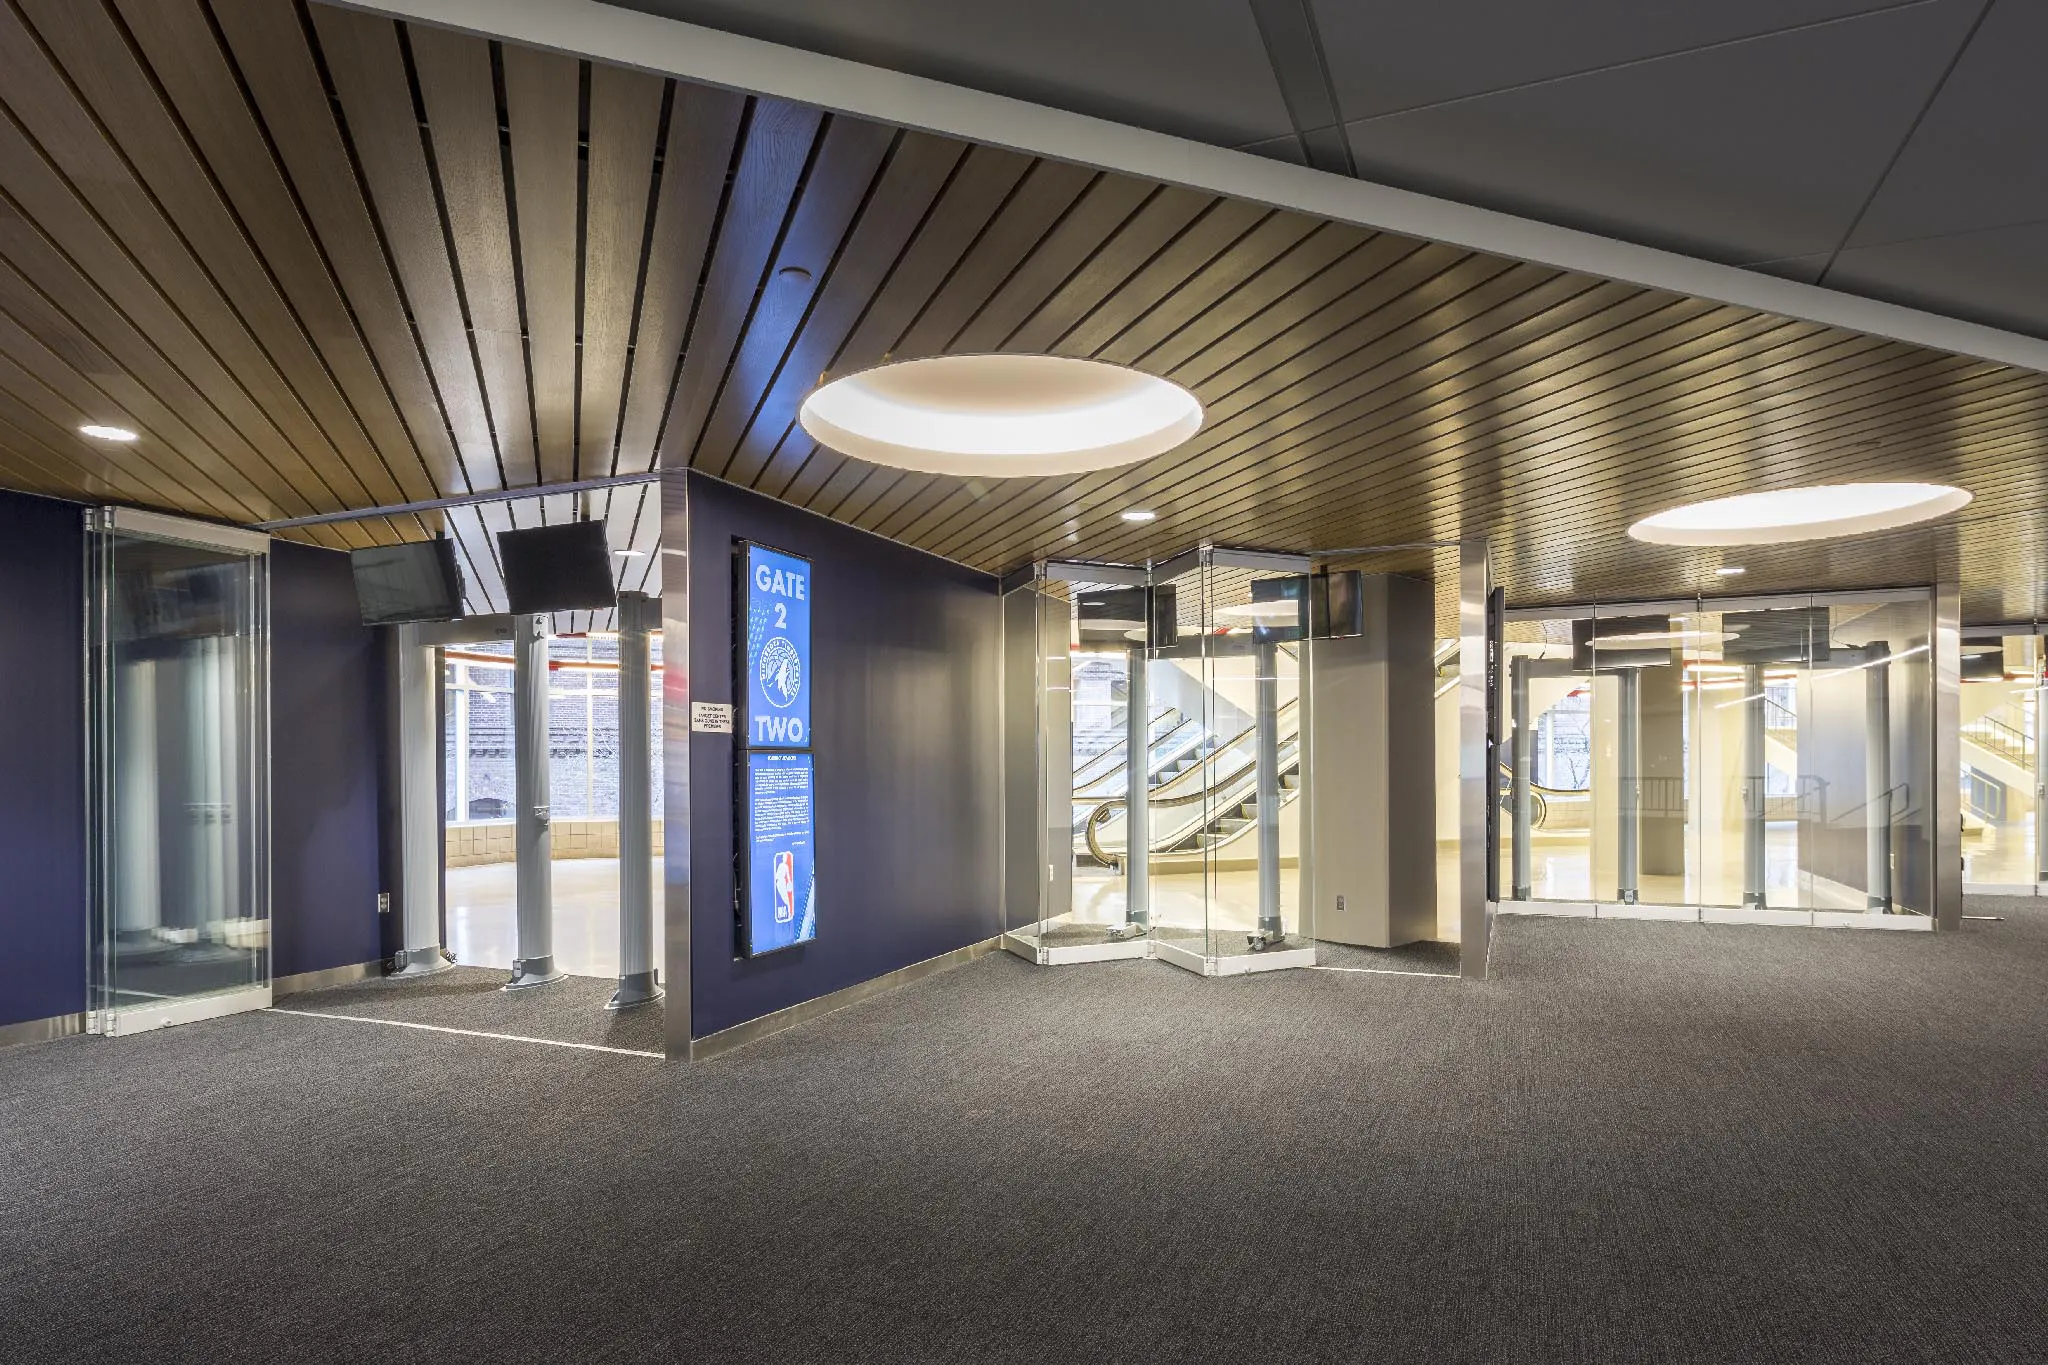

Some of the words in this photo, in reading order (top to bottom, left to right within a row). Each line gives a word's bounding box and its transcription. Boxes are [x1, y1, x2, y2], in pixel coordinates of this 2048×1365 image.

[756, 564, 805, 600] GATE
[774, 602, 787, 629] 2
[755, 715, 803, 742] TWO
